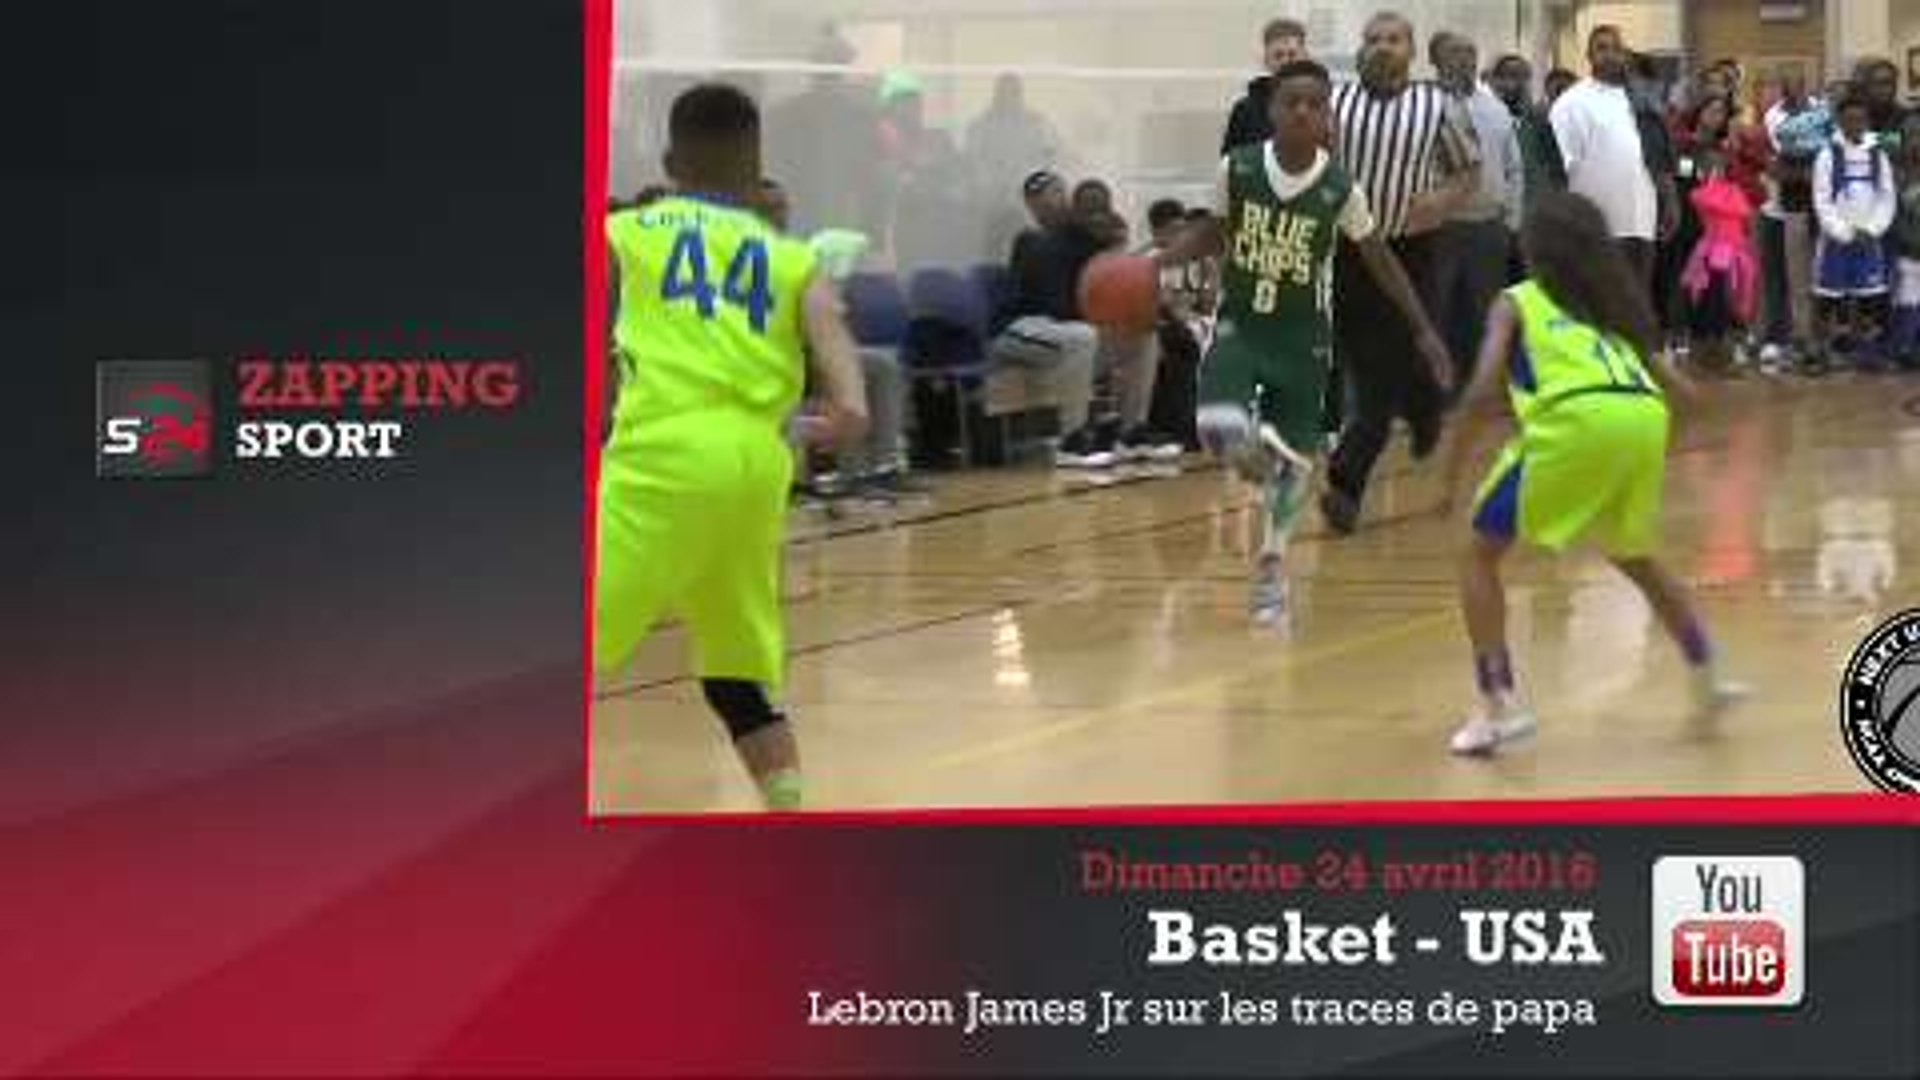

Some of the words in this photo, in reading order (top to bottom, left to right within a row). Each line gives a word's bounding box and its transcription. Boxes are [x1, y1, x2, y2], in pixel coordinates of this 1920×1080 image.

[1243, 202, 1317, 249] BLUE
[661, 228, 774, 337] 44
[1234, 230, 1311, 285] CHIPS
